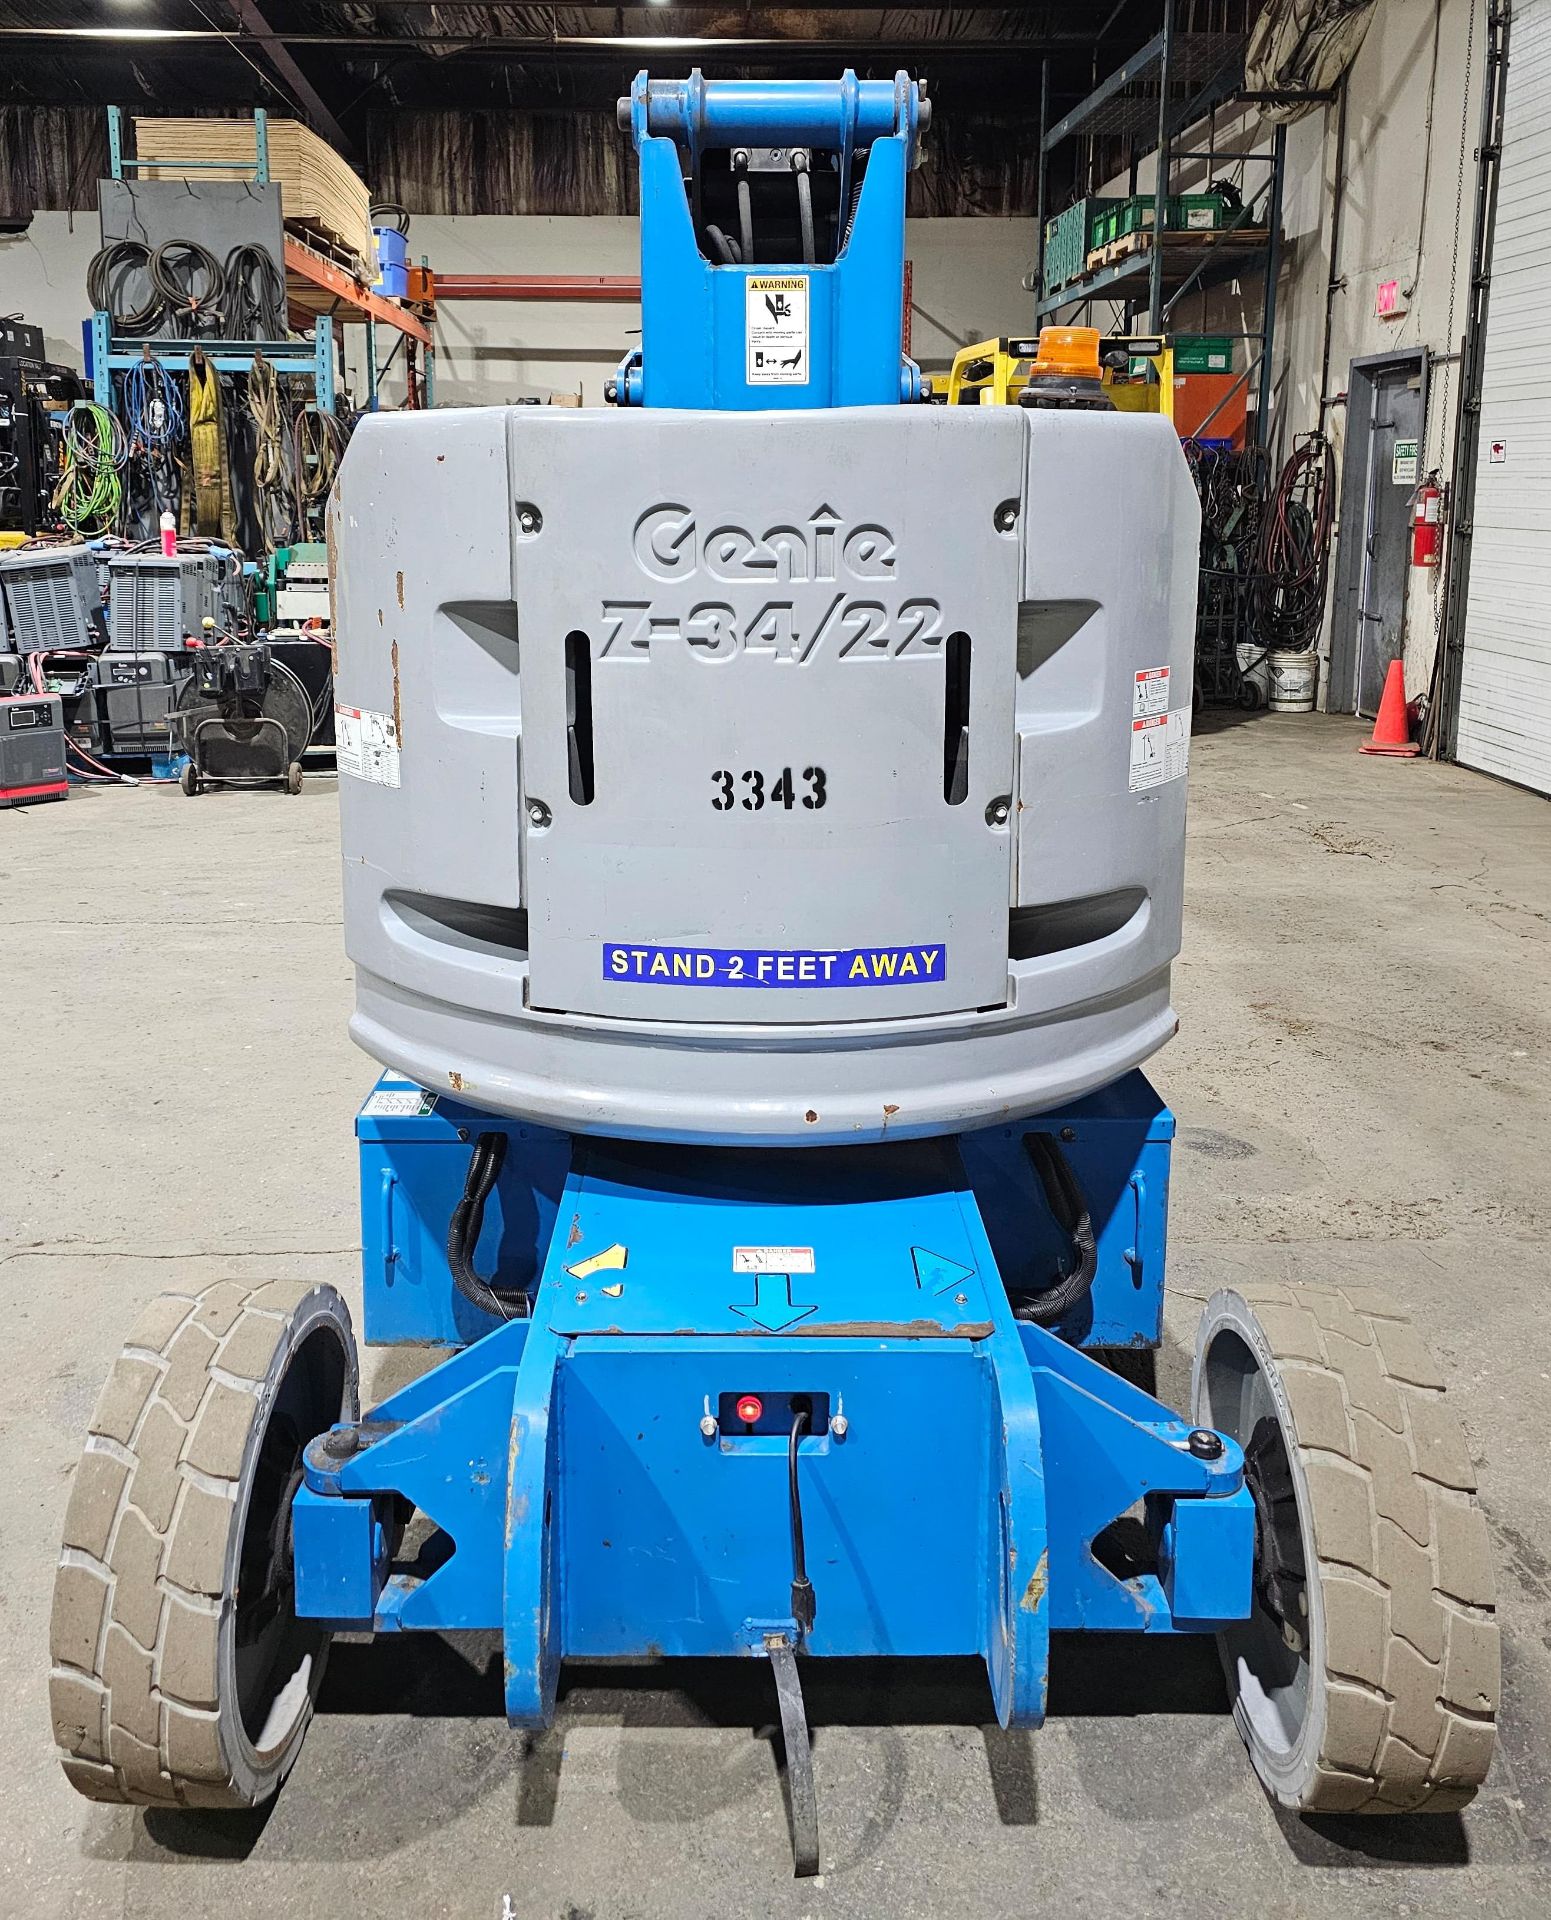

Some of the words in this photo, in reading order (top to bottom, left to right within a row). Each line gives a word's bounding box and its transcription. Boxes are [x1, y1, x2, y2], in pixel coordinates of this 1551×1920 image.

[760, 280, 804, 289] WARNING
[598, 593, 944, 666] Z-34/22
[711, 766, 827, 811] 3343
[611, 949, 715, 978] STAND
[728, 956, 744, 979] 2
[757, 956, 837, 980] FEET
[848, 950, 939, 979] AWAY
